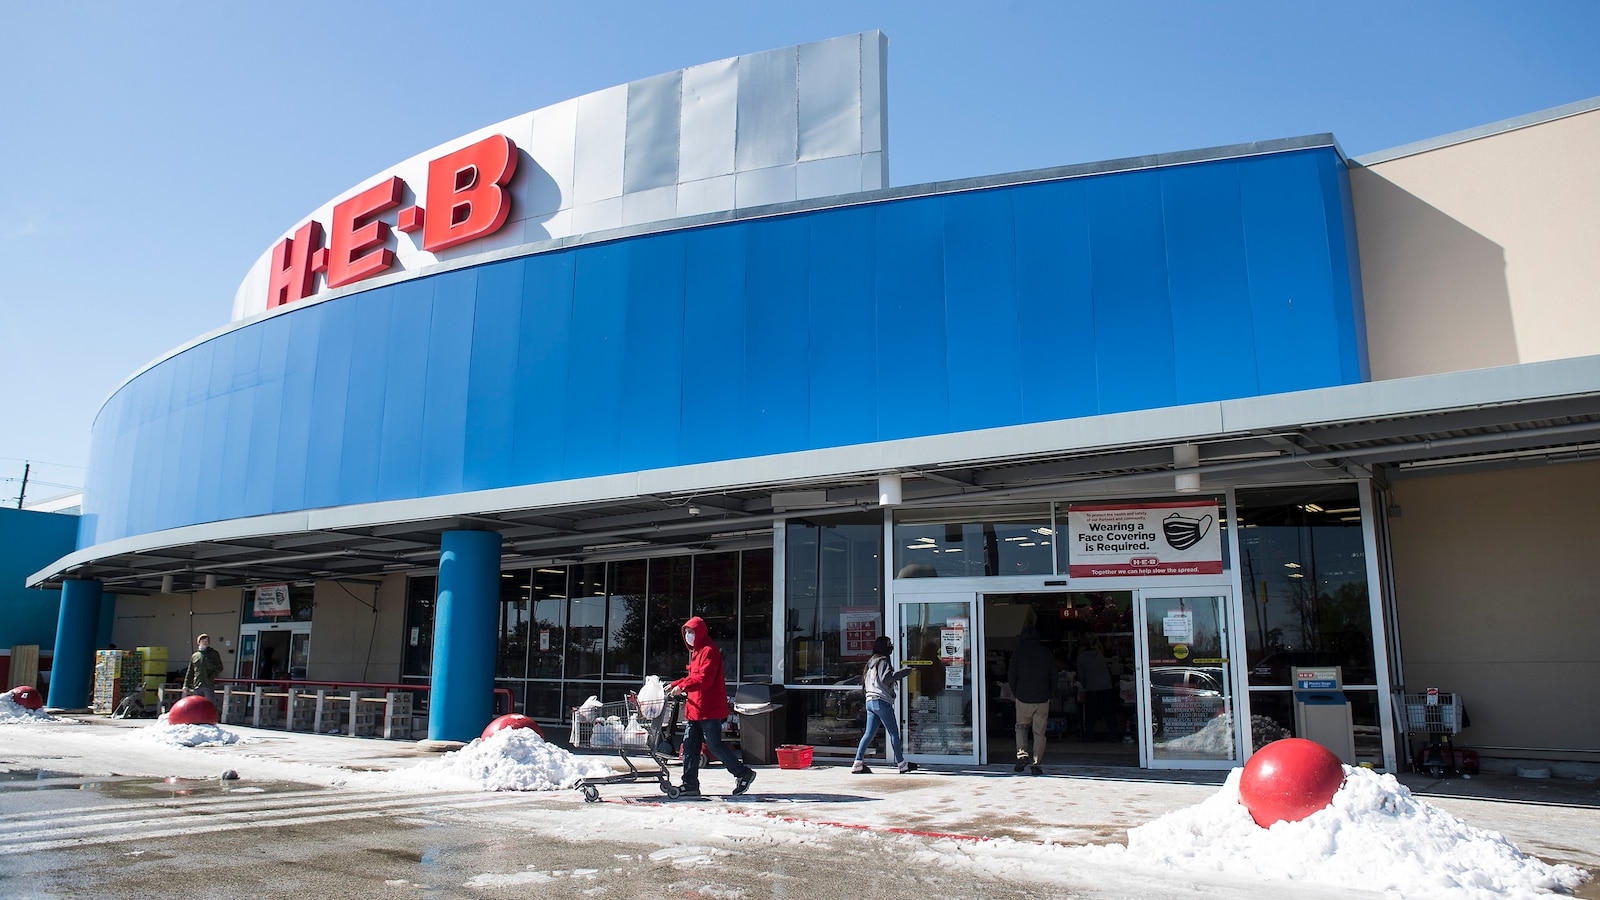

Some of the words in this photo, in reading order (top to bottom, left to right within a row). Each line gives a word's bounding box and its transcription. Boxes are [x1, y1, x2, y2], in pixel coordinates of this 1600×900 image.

[1089, 522, 1135, 531] Wearing
[1106, 532, 1156, 541] Covering
[1086, 543, 1094, 551] is
[1097, 542, 1150, 552] Required.
[1064, 609, 1070, 617] 6
